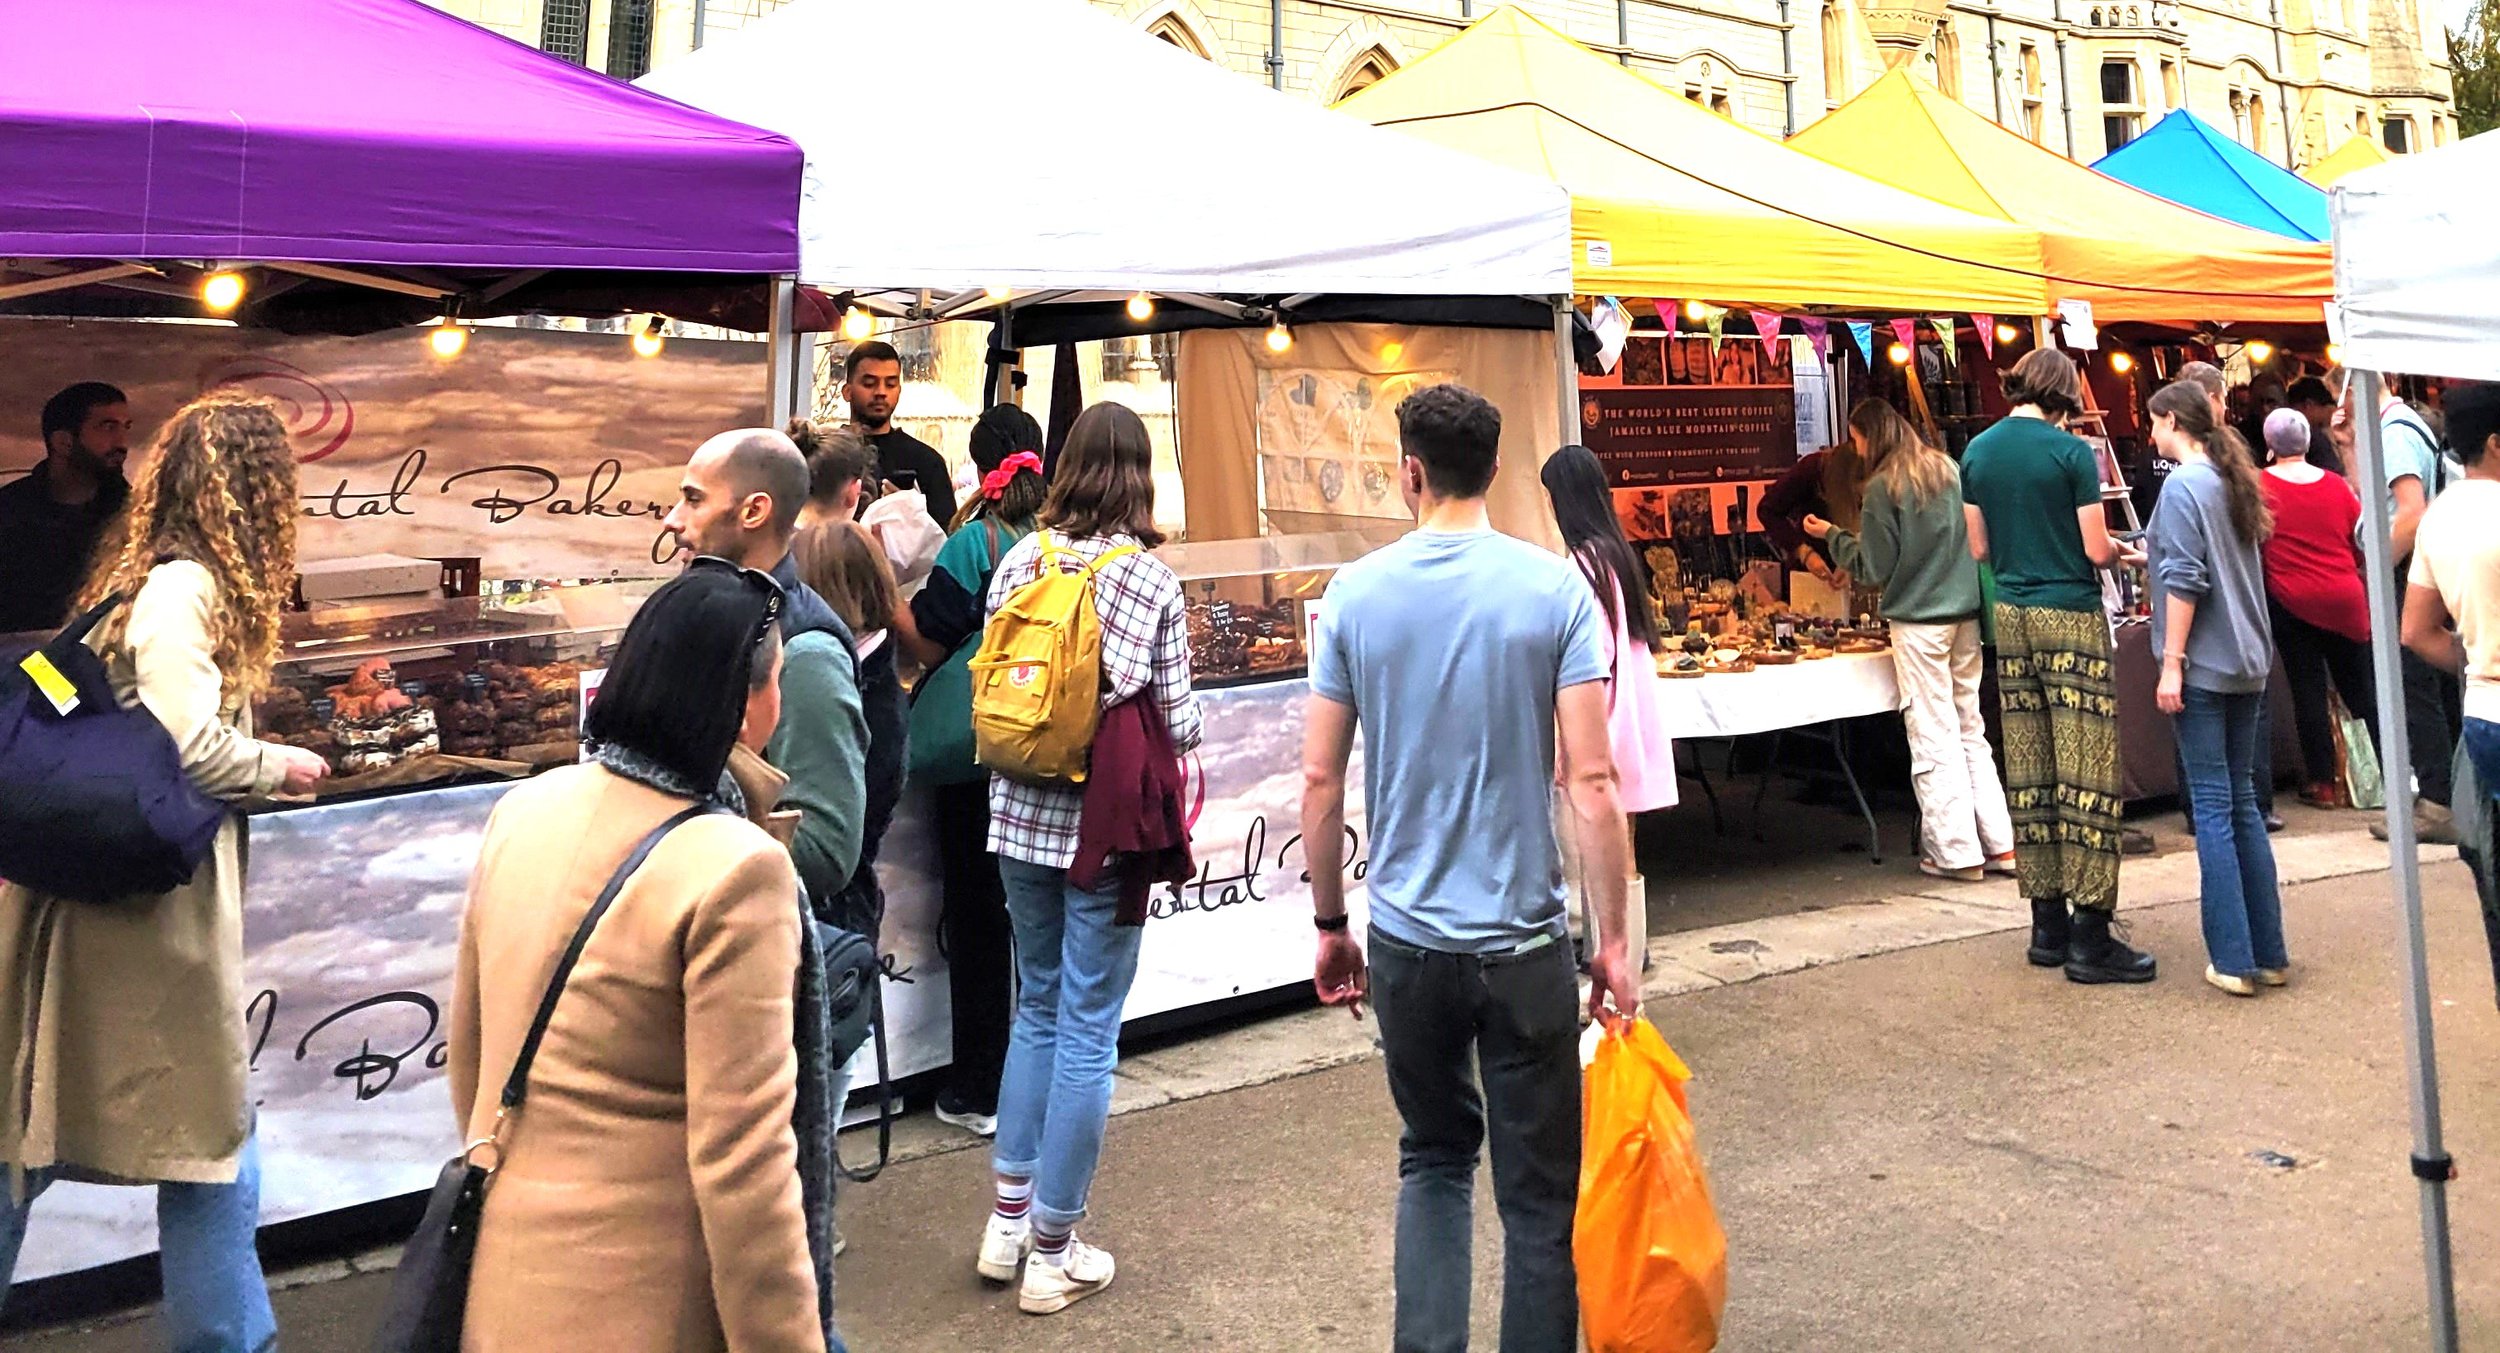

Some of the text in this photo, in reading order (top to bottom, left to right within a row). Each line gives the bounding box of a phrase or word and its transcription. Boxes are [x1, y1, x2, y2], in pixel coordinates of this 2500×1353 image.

[1604, 406, 1774, 418] THE WORLD'S BEST LUXURY COFFEE
[1610, 423, 1770, 438] JAMAICA BLUE MOUNTAIN COFFEE
